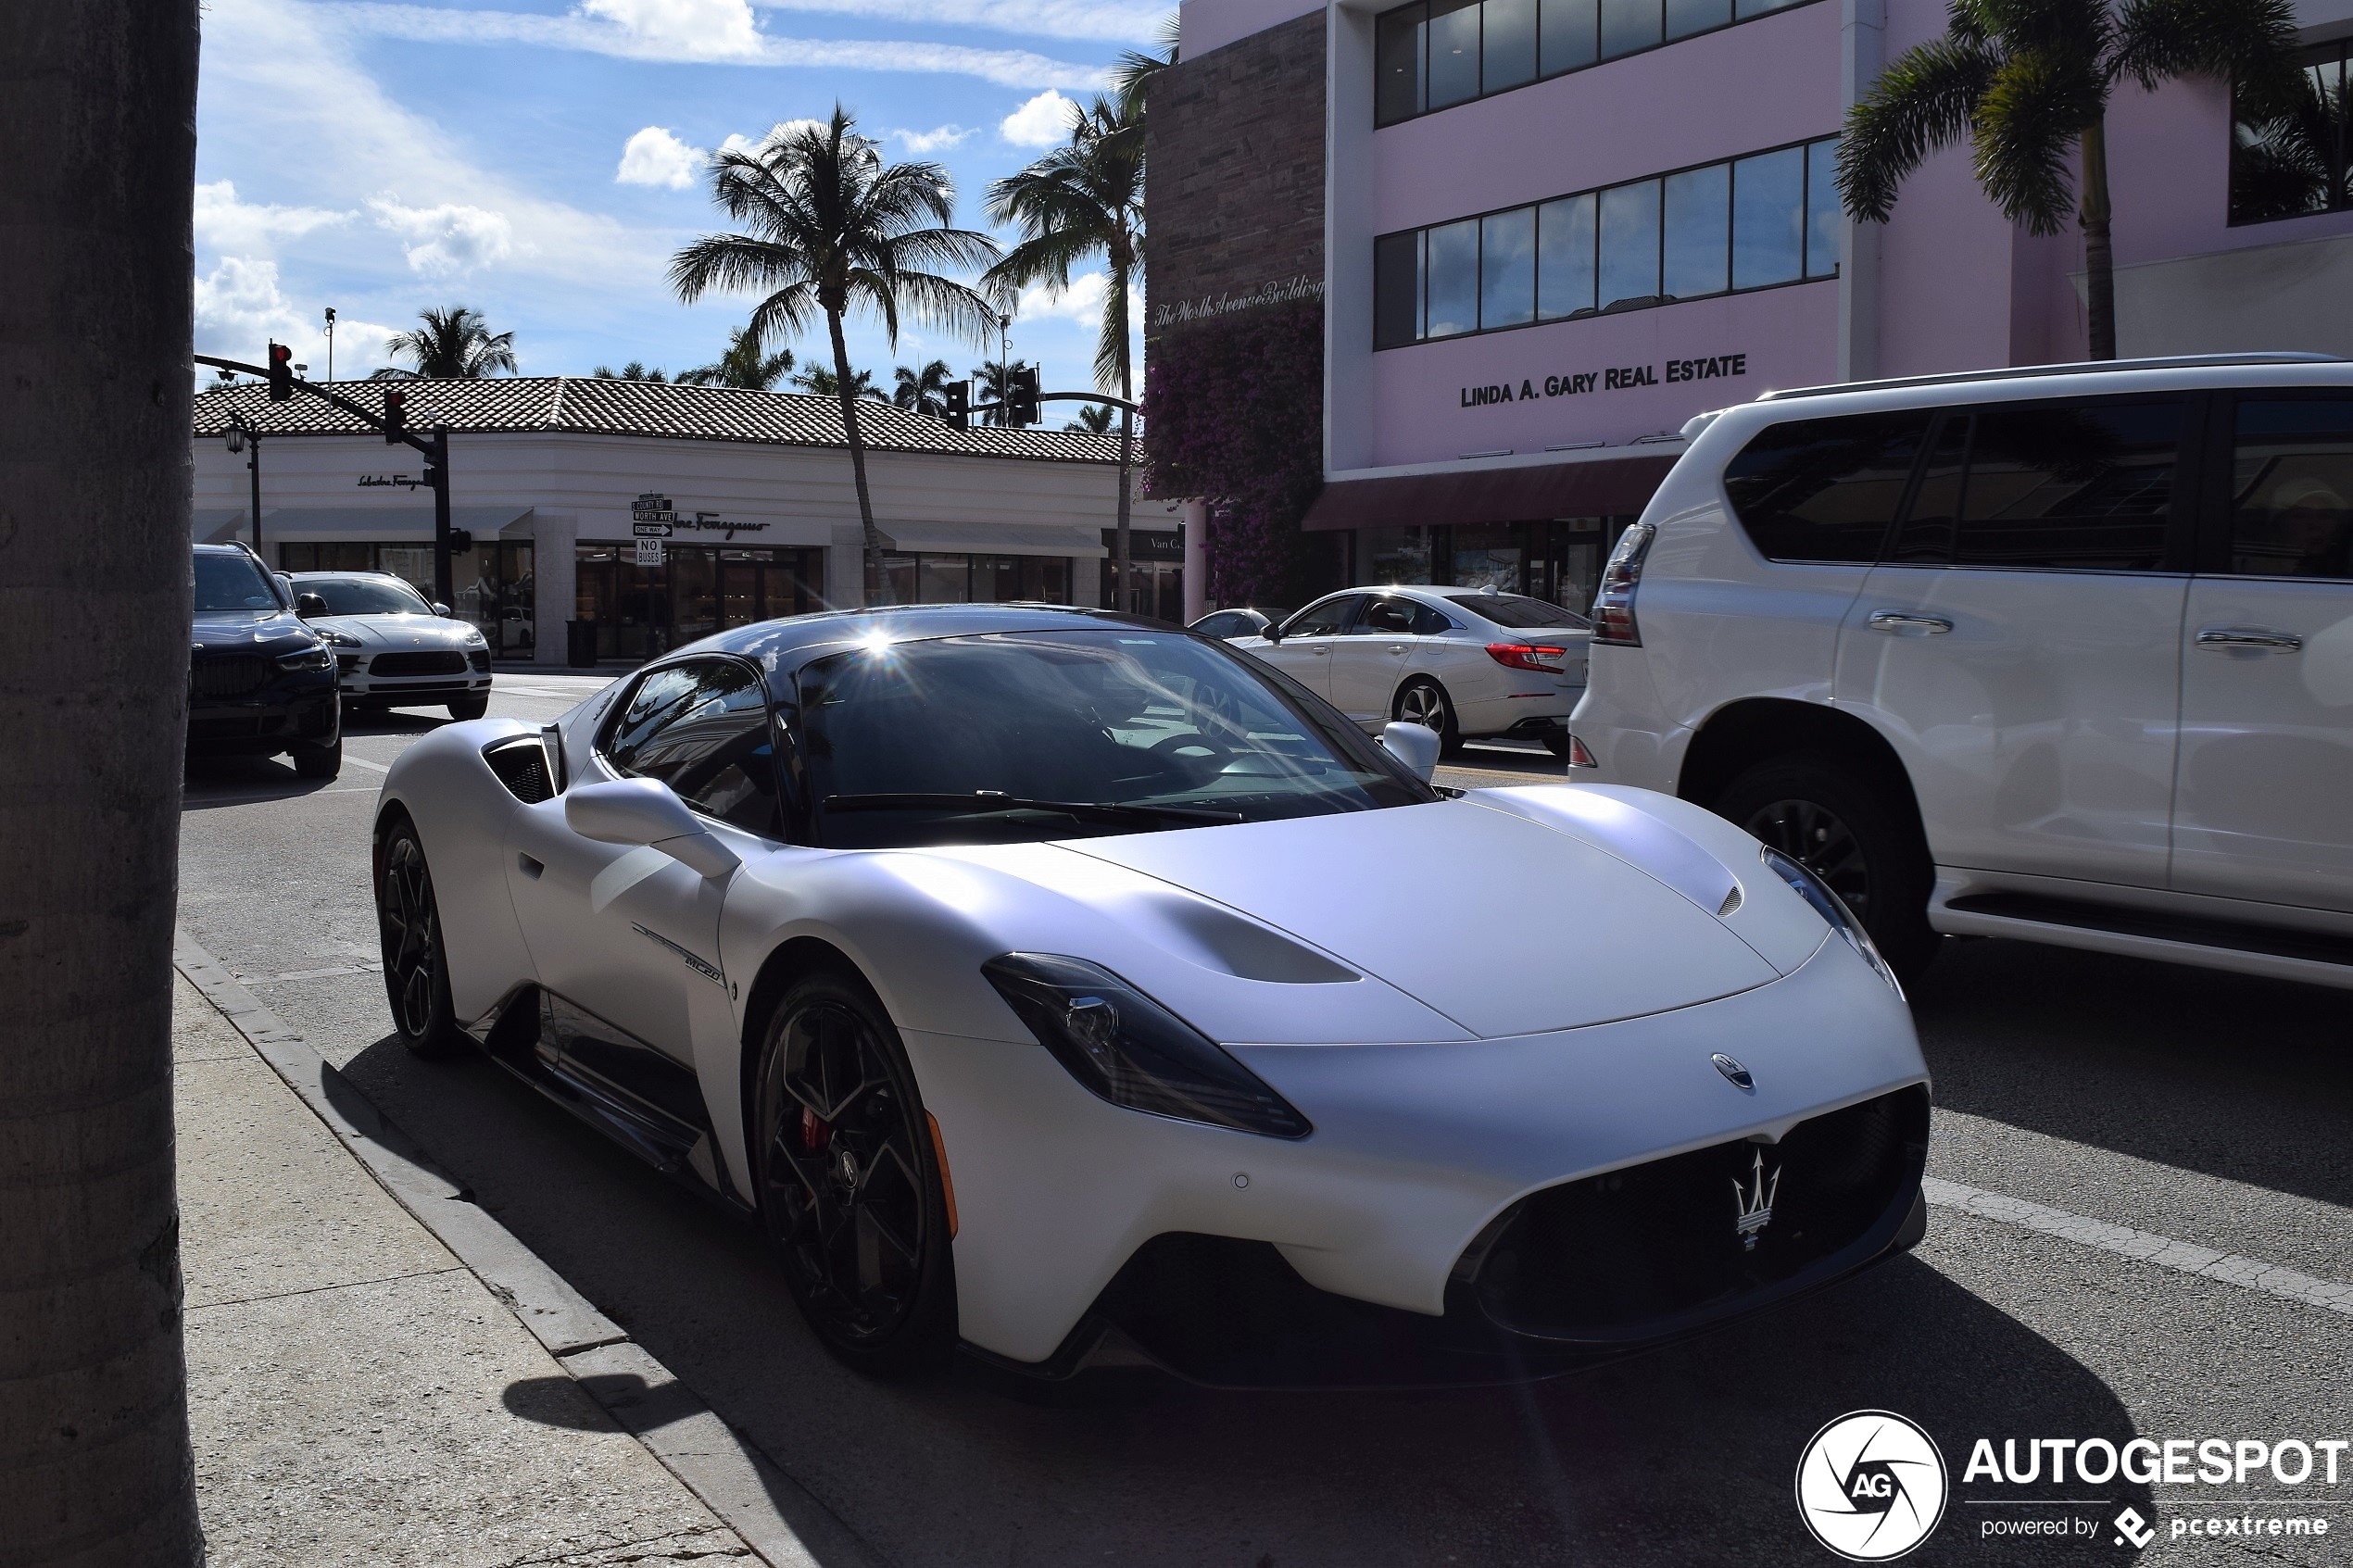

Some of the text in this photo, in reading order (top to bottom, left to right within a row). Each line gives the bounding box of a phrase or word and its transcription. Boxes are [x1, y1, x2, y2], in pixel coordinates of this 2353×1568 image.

[1154, 274, 1326, 326] The Worth Avenue Building
[1461, 354, 1746, 408] LINDA A. GARY REAL ESTATE
[637, 500, 654, 509] COUNTY
[635, 512, 673, 521] WORTH AVE
[696, 512, 771, 541] Ferragamo
[641, 541, 657, 550] NO
[1151, 537, 1168, 549] Van
[638, 553, 660, 562] BUSES
[686, 957, 721, 981] MC20
